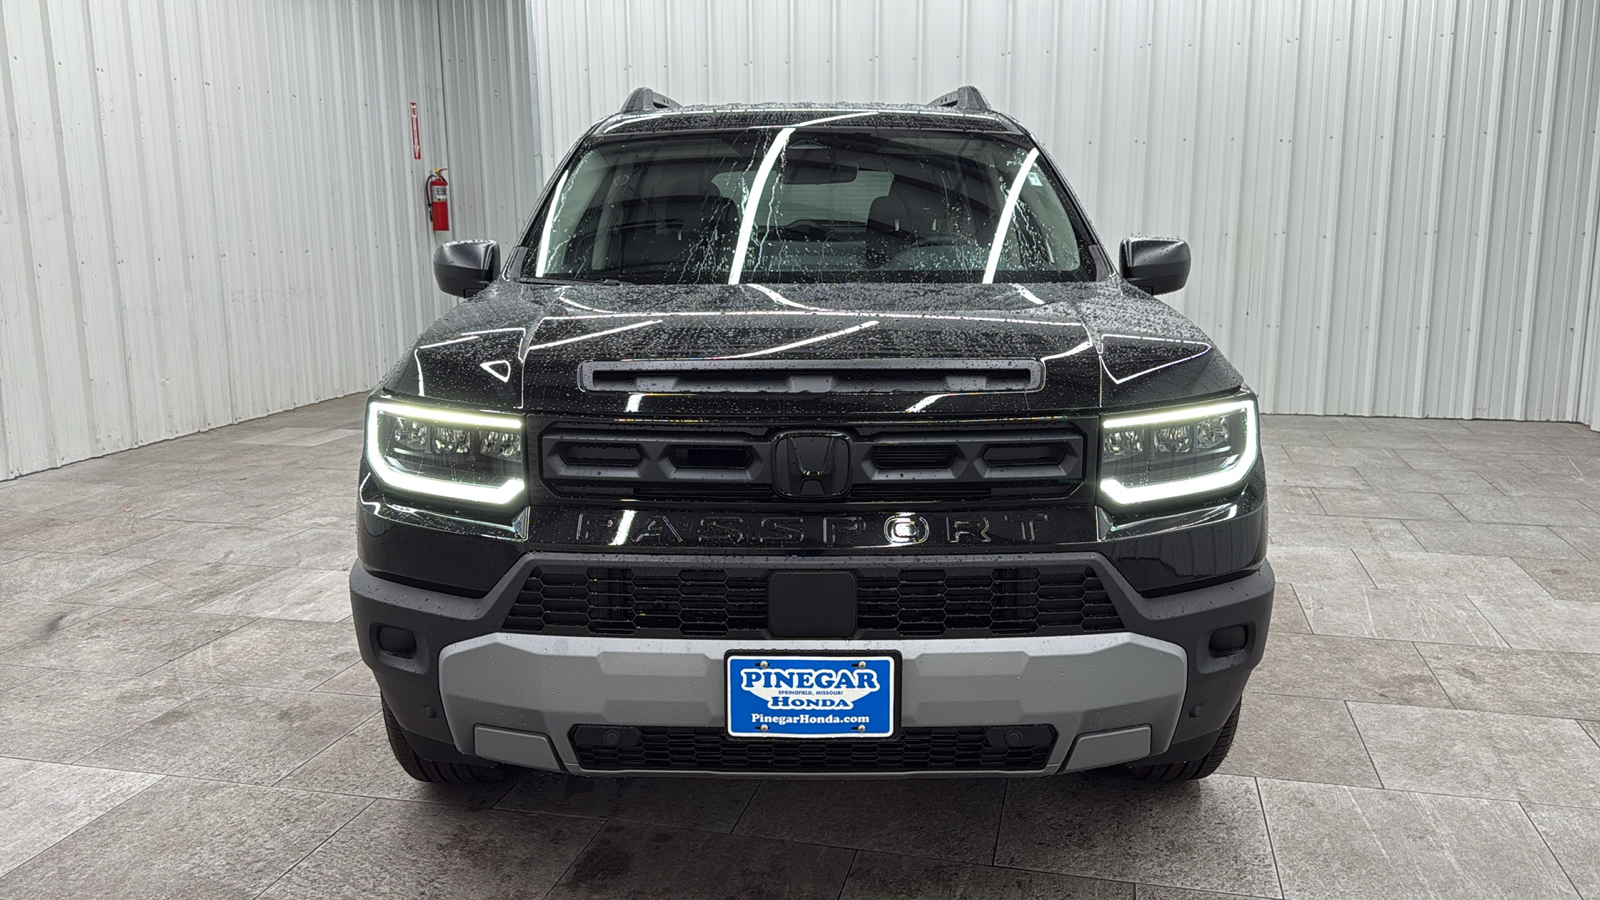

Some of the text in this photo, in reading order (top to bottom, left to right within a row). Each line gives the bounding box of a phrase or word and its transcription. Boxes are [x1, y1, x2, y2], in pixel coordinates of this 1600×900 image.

[577, 512, 1048, 543] PASSPORT
[744, 671, 880, 689] PINEGAR
[751, 713, 870, 725] PinegarHonda.com
